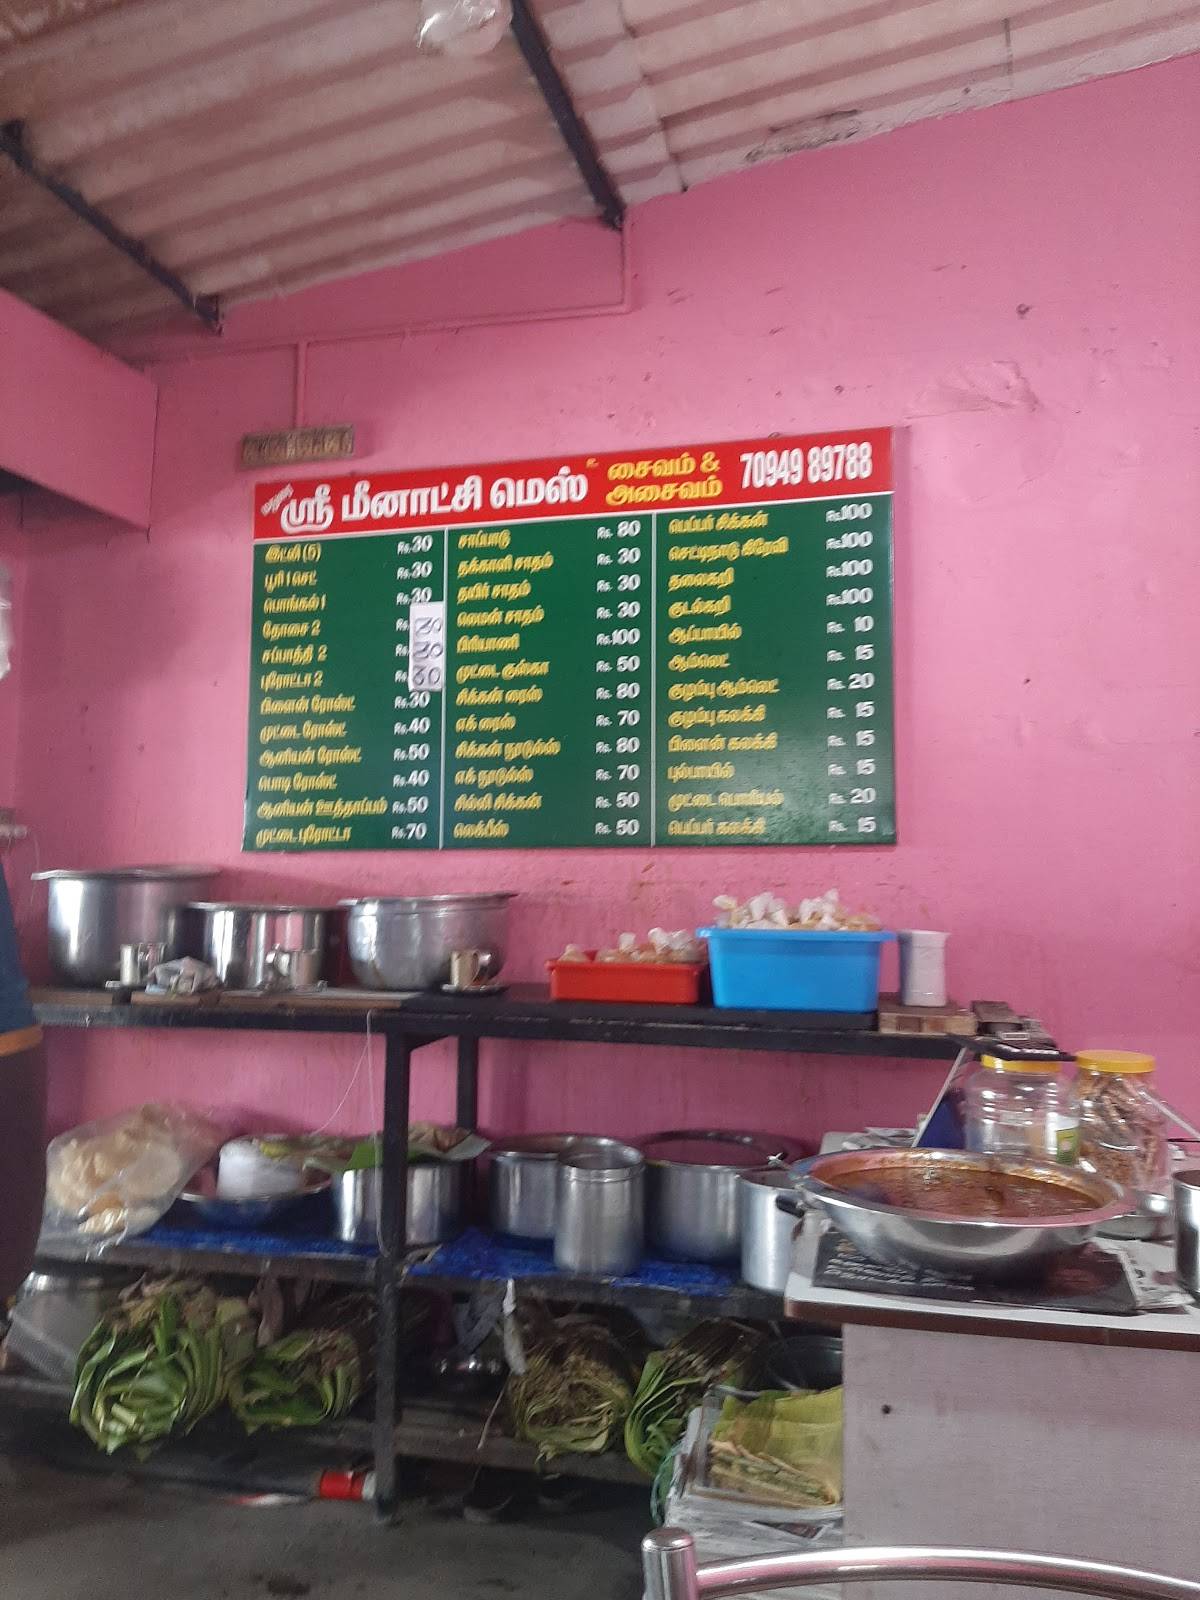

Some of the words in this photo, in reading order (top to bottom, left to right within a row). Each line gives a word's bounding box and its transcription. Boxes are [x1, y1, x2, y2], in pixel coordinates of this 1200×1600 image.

[607, 452, 695, 481] சைவம்
[700, 451, 720, 472] &
[740, 447, 802, 489] 70949
[807, 441, 872, 485] 89788
[341, 475, 483, 523] மீனாட்சி
[489, 465, 588, 509] மெஸ்
[605, 476, 723, 506] அசைவம்
[617, 520, 641, 538] 80
[715, 510, 769, 531] சிக்கன்
[458, 529, 511, 549] சாப்பாடு
[265, 543, 301, 563] இட்லி
[617, 548, 641, 565] 30
[668, 541, 740, 562] செட்டிநாடு
[457, 554, 513, 579] தக்காளி
[514, 551, 554, 574] சாதம்
[264, 570, 284, 593] பூரி
[491, 579, 531, 601] சாதம்
[617, 574, 641, 591] 30
[263, 594, 319, 614] பொங்கல்
[617, 602, 641, 618] 30
[504, 604, 545, 627] சாதம்
[854, 616, 874, 632] 10
[262, 620, 310, 641] தோசை
[311, 619, 320, 636] 2
[457, 633, 520, 654] பிரியாணி
[854, 644, 874, 660] 15
[261, 644, 314, 666] சப்பாத்தி
[318, 645, 328, 662] 2
[617, 656, 641, 672] 50
[313, 670, 323, 687] 2
[456, 664, 500, 684] முட்டை
[849, 672, 874, 690] 20
[456, 686, 504, 706] சிக்கன்
[617, 683, 641, 699] 80
[617, 710, 641, 726] 70
[717, 704, 766, 722] கலக்கி
[856, 701, 875, 718] 15
[259, 724, 301, 744] முட்டை
[727, 732, 778, 750] கலக்கி
[856, 729, 875, 747] 15
[455, 739, 504, 759] சிக்கன்
[617, 737, 641, 753] 80
[259, 746, 315, 768] ஆனியன்
[857, 758, 875, 776] 15
[617, 764, 641, 780] 70
[493, 792, 543, 811] சிக்கன்
[617, 792, 641, 808] 50
[668, 792, 717, 812] முட்டை
[849, 787, 876, 804] 20
[256, 798, 314, 820] ஆனியன்
[617, 819, 641, 835] 50
[716, 816, 766, 836] கலக்கி
[857, 816, 876, 833] 15
[256, 827, 298, 848] முட்டை
